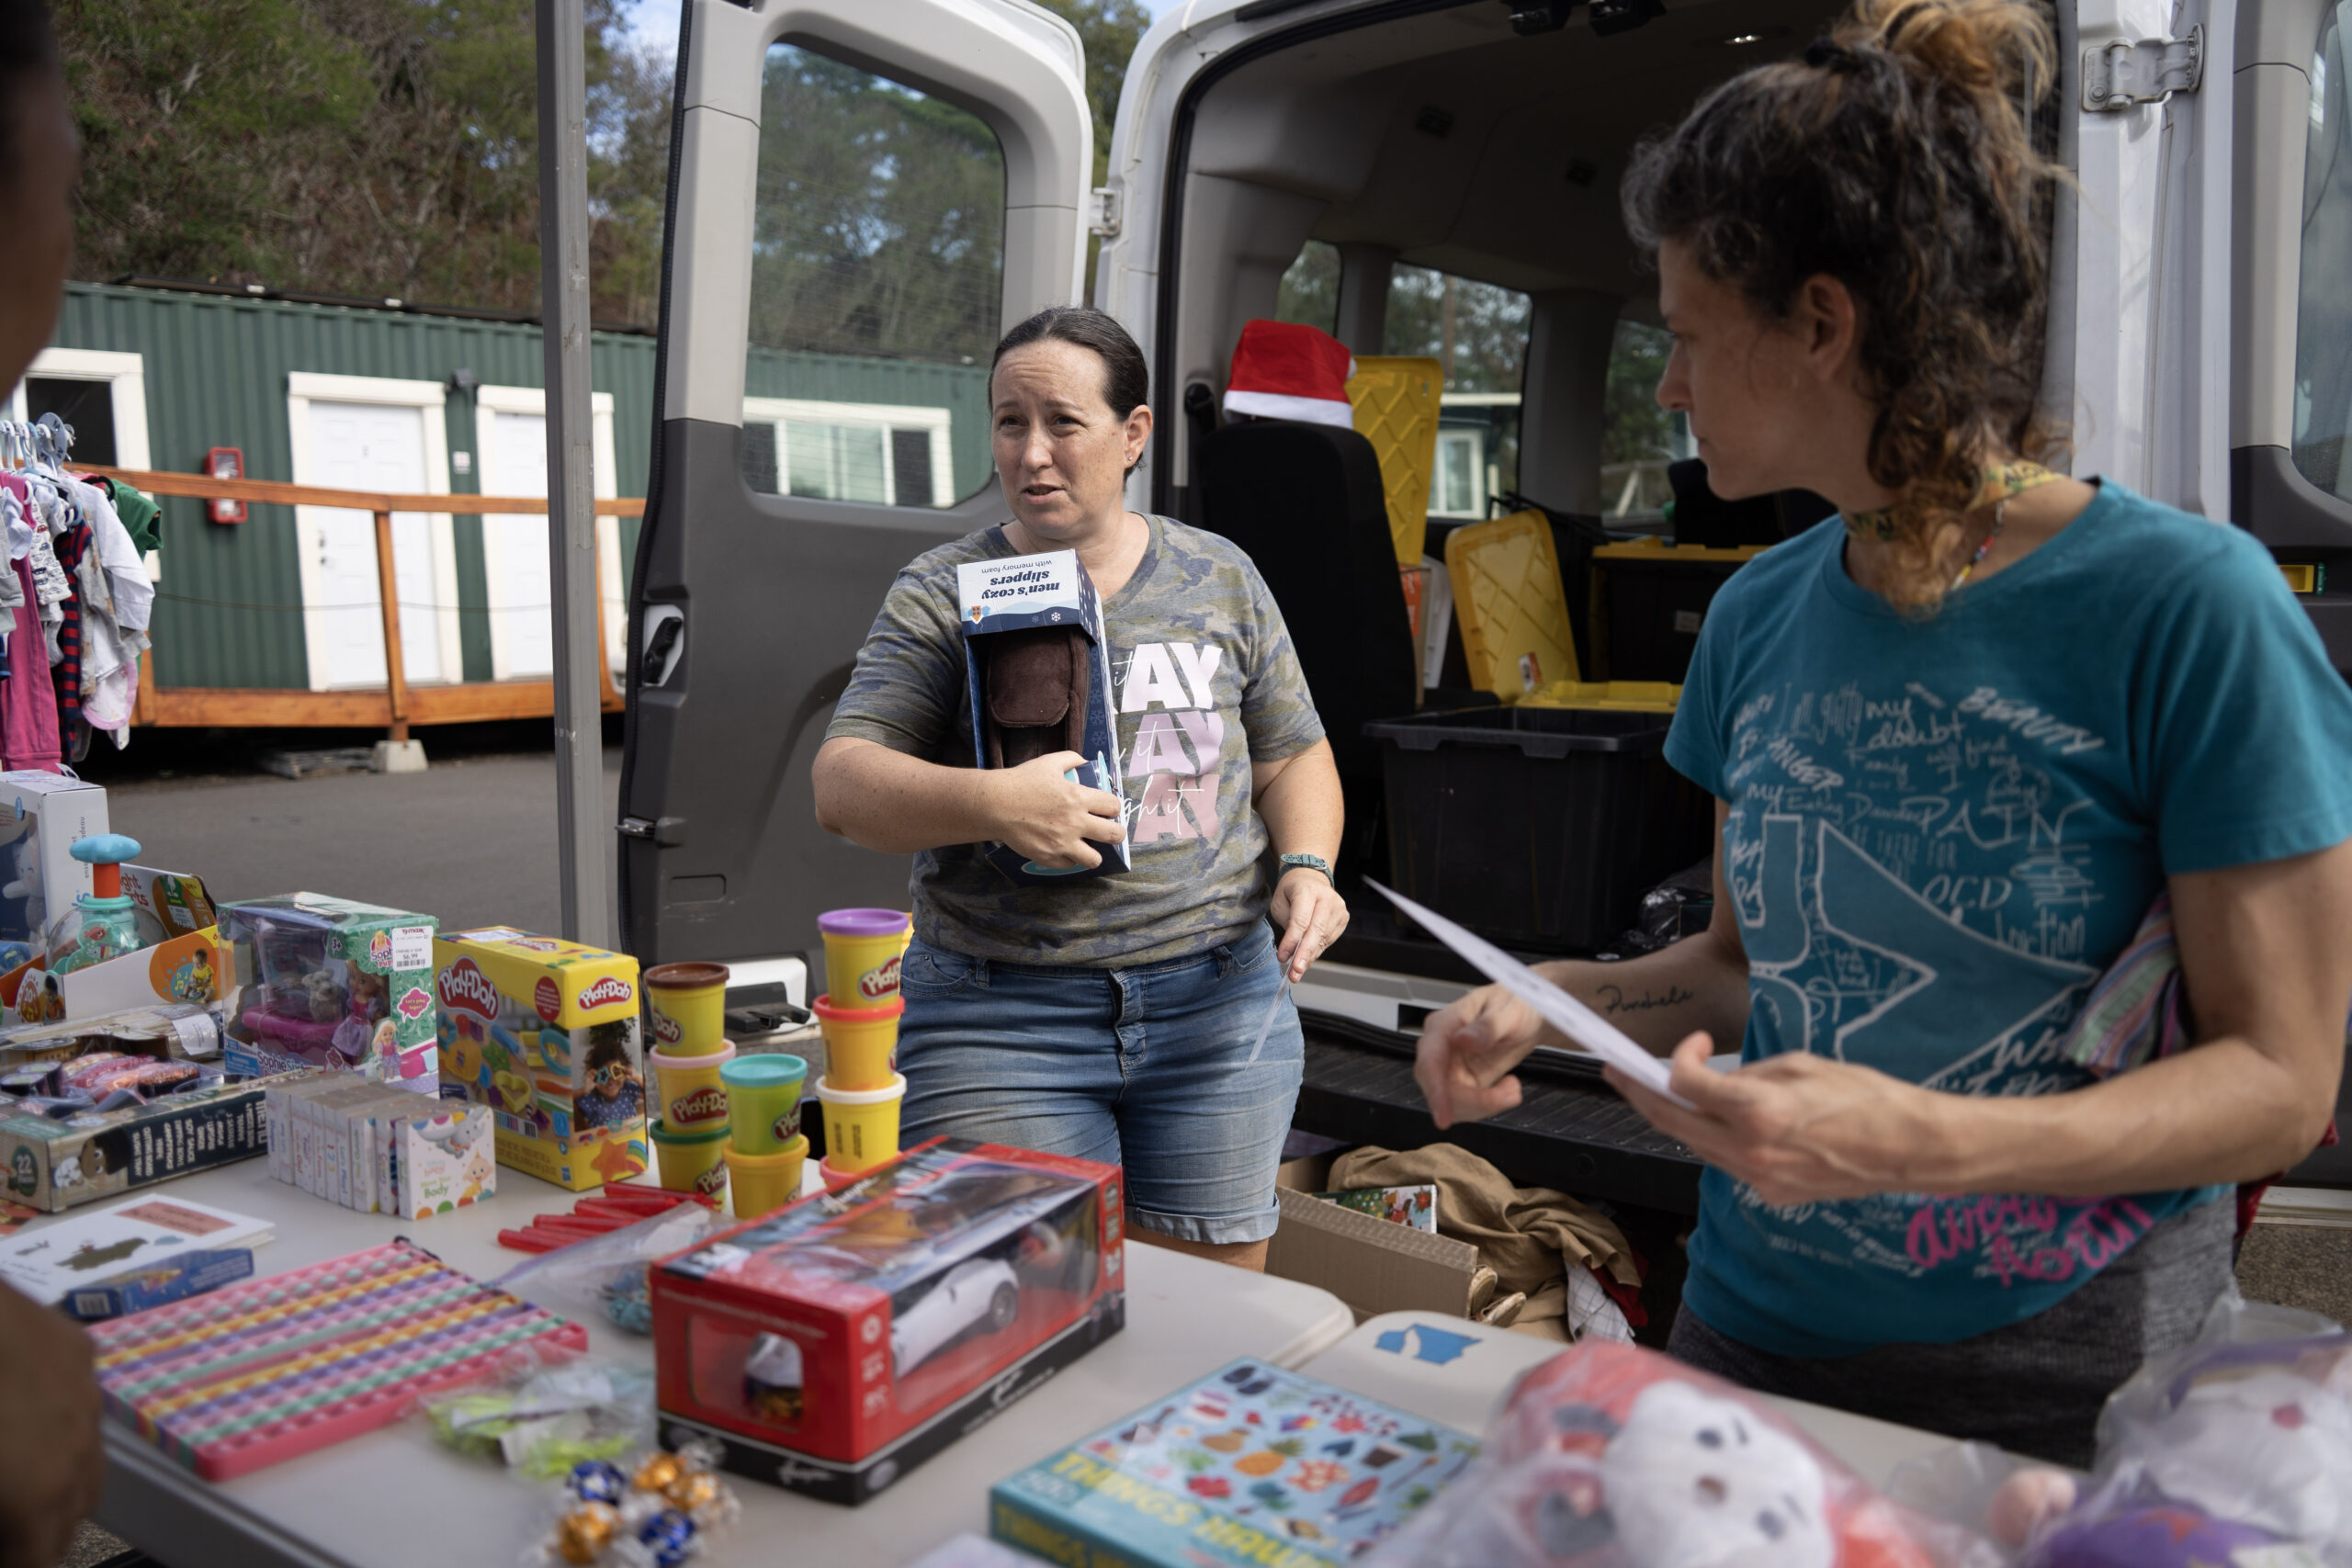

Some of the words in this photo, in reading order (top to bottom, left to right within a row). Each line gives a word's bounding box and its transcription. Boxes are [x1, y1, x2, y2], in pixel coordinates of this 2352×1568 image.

[981, 565, 1001, 574] foam
[1001, 561, 1034, 571] memory
[1035, 559, 1053, 568] with
[989, 570, 1050, 586] slippers
[1017, 582, 1060, 596] men's
[981, 588, 1015, 600] cozy
[1119, 642, 1224, 713] AY
[1865, 697, 1917, 739] my
[1868, 711, 1966, 750] doubt
[1958, 687, 2105, 755] BEAUTY
[1127, 710, 1225, 777] AY
[1767, 736, 1845, 793] ANGER
[1132, 773, 1221, 843] AY
[1747, 783, 1785, 816] my
[1899, 796, 2095, 852] PAIN
[1922, 874, 2013, 909] OCD
[332, 939, 342, 950] 3+
[371, 948, 392, 962] Soph
[439, 968, 497, 1016] Play-Doh
[580, 980, 632, 1007] Play-Doh
[257, 1051, 287, 1072] Sophie
[672, 1092, 729, 1121] Play-Do
[142, 1126, 153, 1154] CUTTING
[185, 1119, 194, 1135] SOY
[187, 1137, 195, 1163] SAUCE
[327, 1153, 335, 1162] 2
[17, 1154, 33, 1174] 22
[133, 1156, 142, 1177] TRAY
[145, 1155, 154, 1177] BOARD
[424, 1183, 449, 1198] Body
[1051, 1450, 1200, 1526] THINGS
